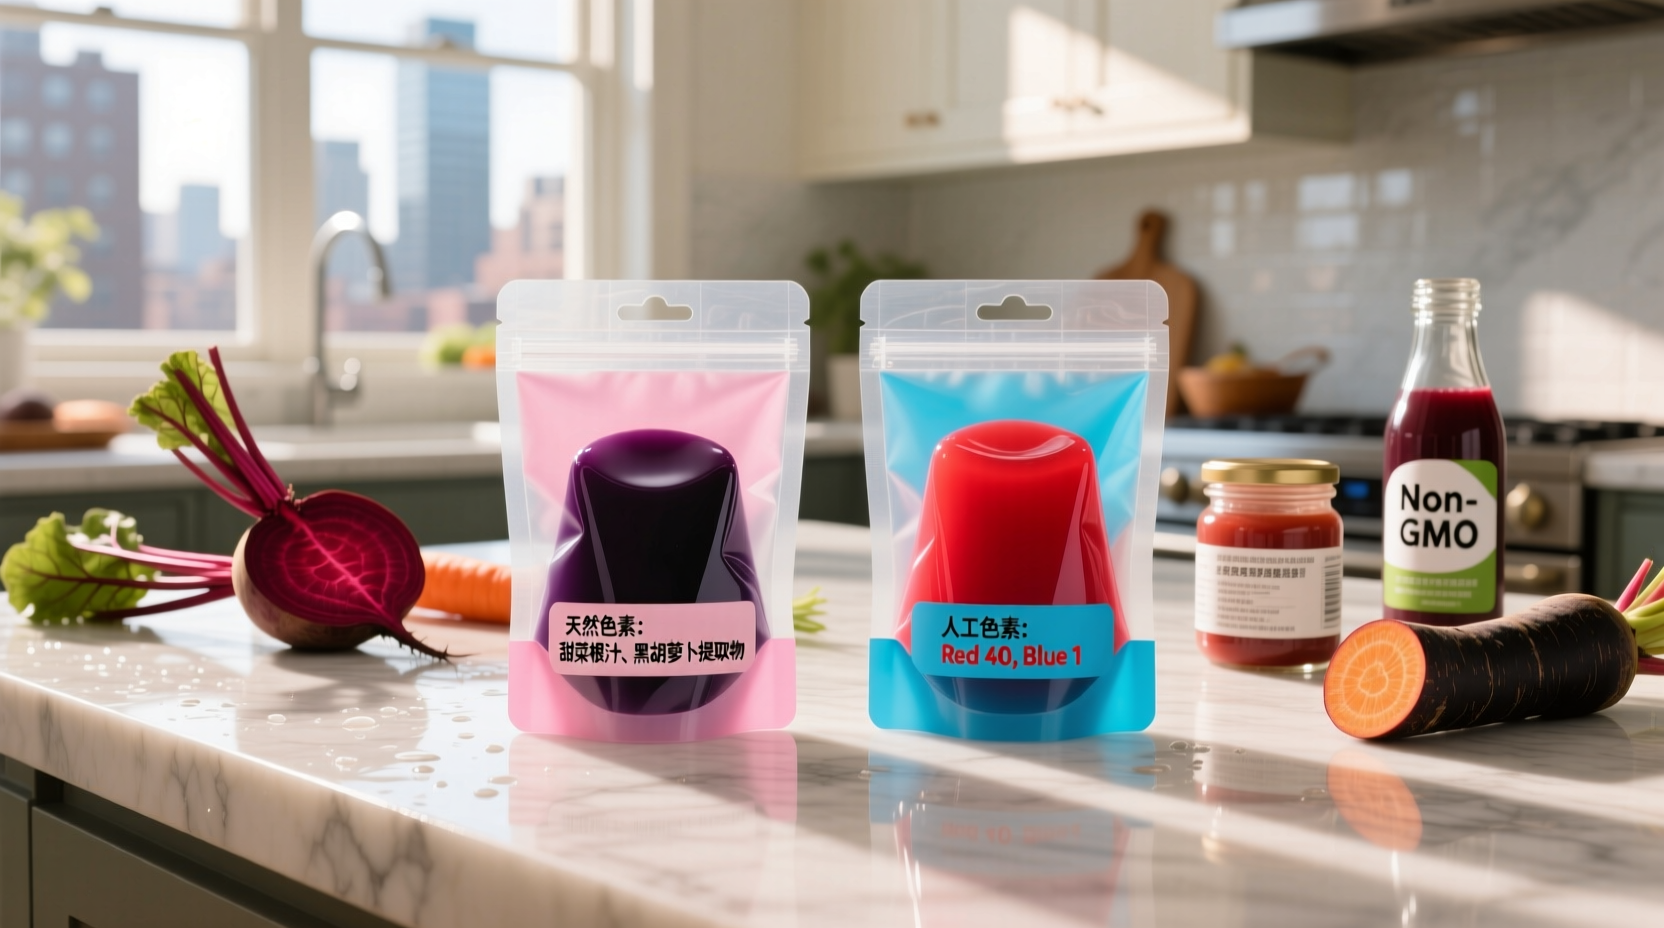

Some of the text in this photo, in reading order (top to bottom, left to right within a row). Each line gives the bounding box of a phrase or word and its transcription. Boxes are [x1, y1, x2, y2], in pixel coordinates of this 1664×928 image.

[1401, 484, 1478, 513] Non-
[1400, 518, 1479, 549] GMO
[941, 644, 1081, 669] Red 40, Blue 1
